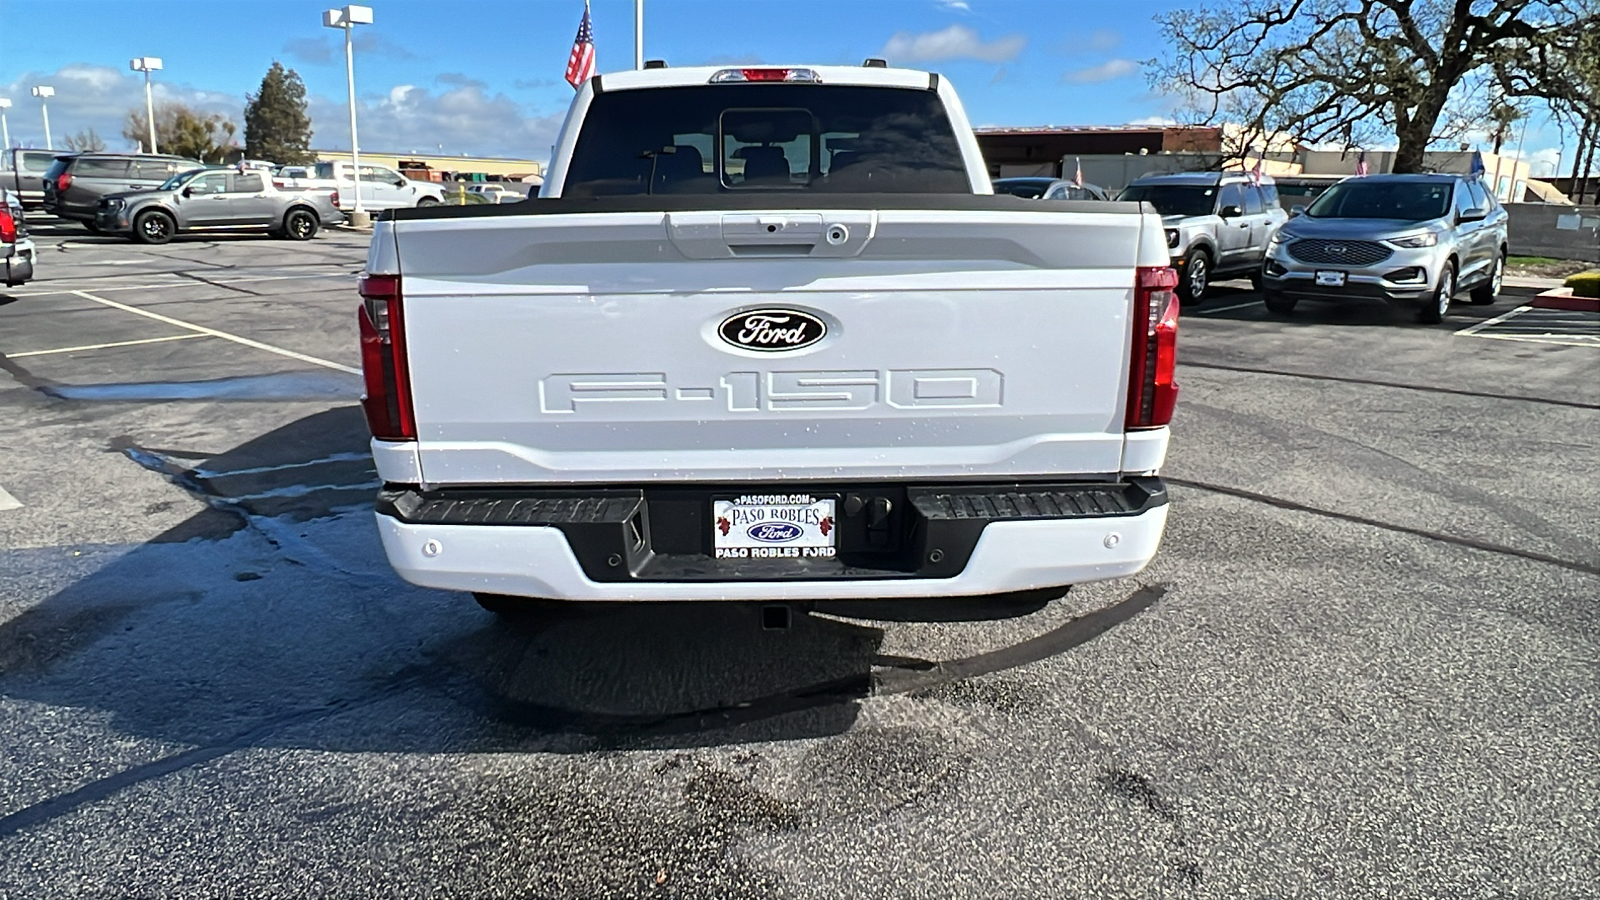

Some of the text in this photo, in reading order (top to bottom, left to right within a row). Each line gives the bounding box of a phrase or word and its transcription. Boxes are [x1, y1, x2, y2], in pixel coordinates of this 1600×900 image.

[738, 315, 807, 344] Ford
[538, 369, 1005, 414] F-150
[740, 494, 810, 505] PASOFORD.COM
[732, 508, 820, 526] PASO ROBLES
[758, 525, 794, 539] Ford
[715, 547, 837, 559] PASO ROBLES FORD
